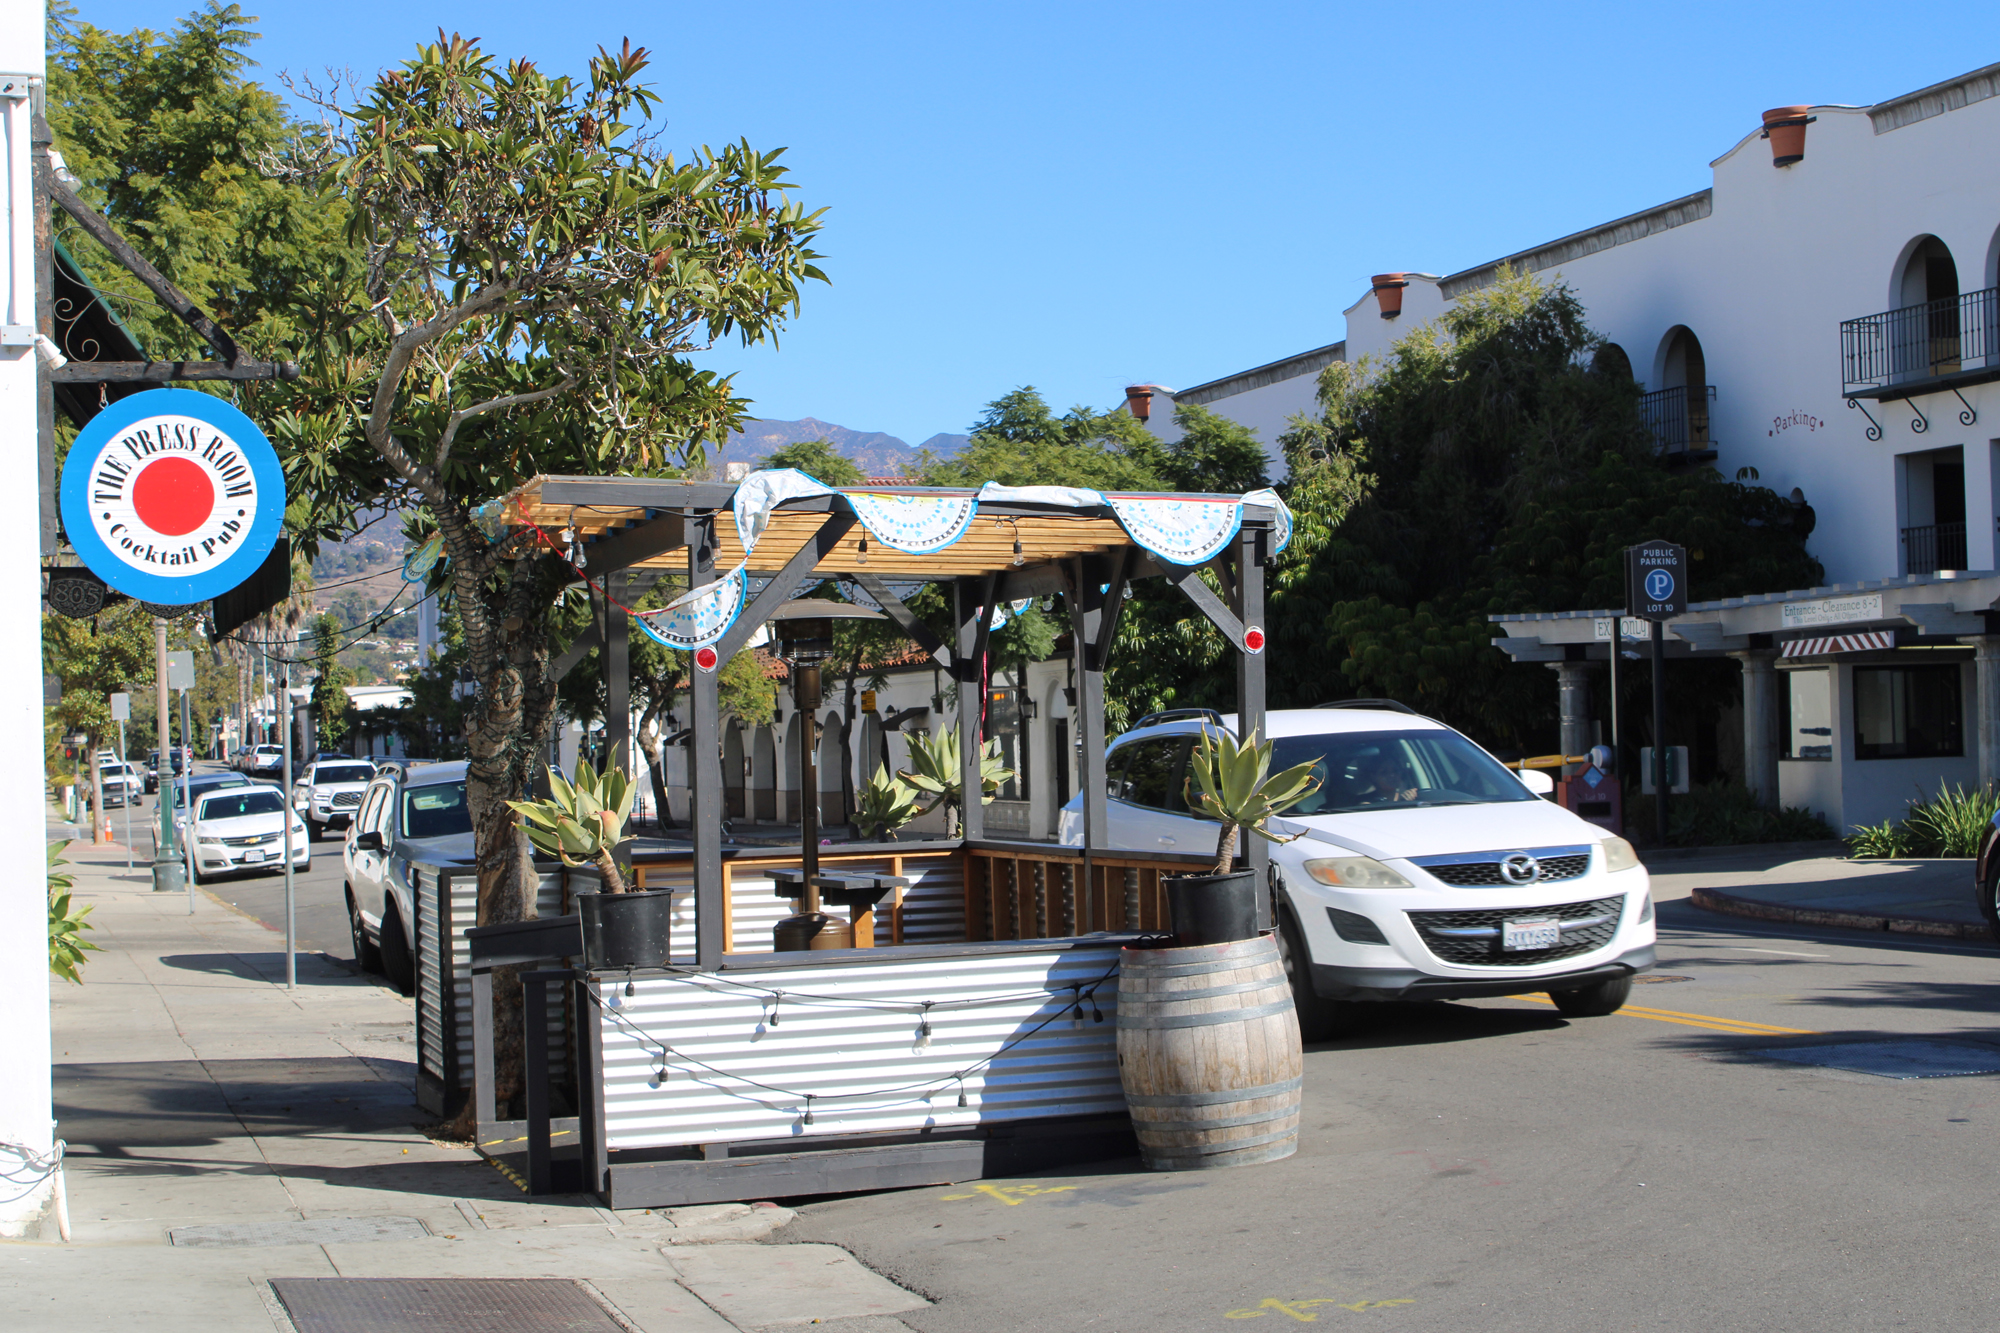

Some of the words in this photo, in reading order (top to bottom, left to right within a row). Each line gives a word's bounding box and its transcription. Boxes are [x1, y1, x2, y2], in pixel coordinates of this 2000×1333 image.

[1773, 409, 1817, 434] Parking
[94, 454, 132, 504] THE
[121, 423, 201, 462] PRESS
[202, 435, 254, 500] ROOM
[110, 523, 199, 566] Cocktail
[200, 518, 242, 557] Pub
[1640, 557, 1678, 566] PARKING
[1643, 549, 1674, 557] PUBLIC
[1653, 574, 1668, 595] P
[54, 583, 99, 606] 805
[1647, 604, 1663, 612] LOT
[1665, 604, 1674, 612] 10
[1784, 605, 1817, 617] Entrance
[1822, 600, 1860, 613] Clearance
[1598, 621, 1612, 636] EX
